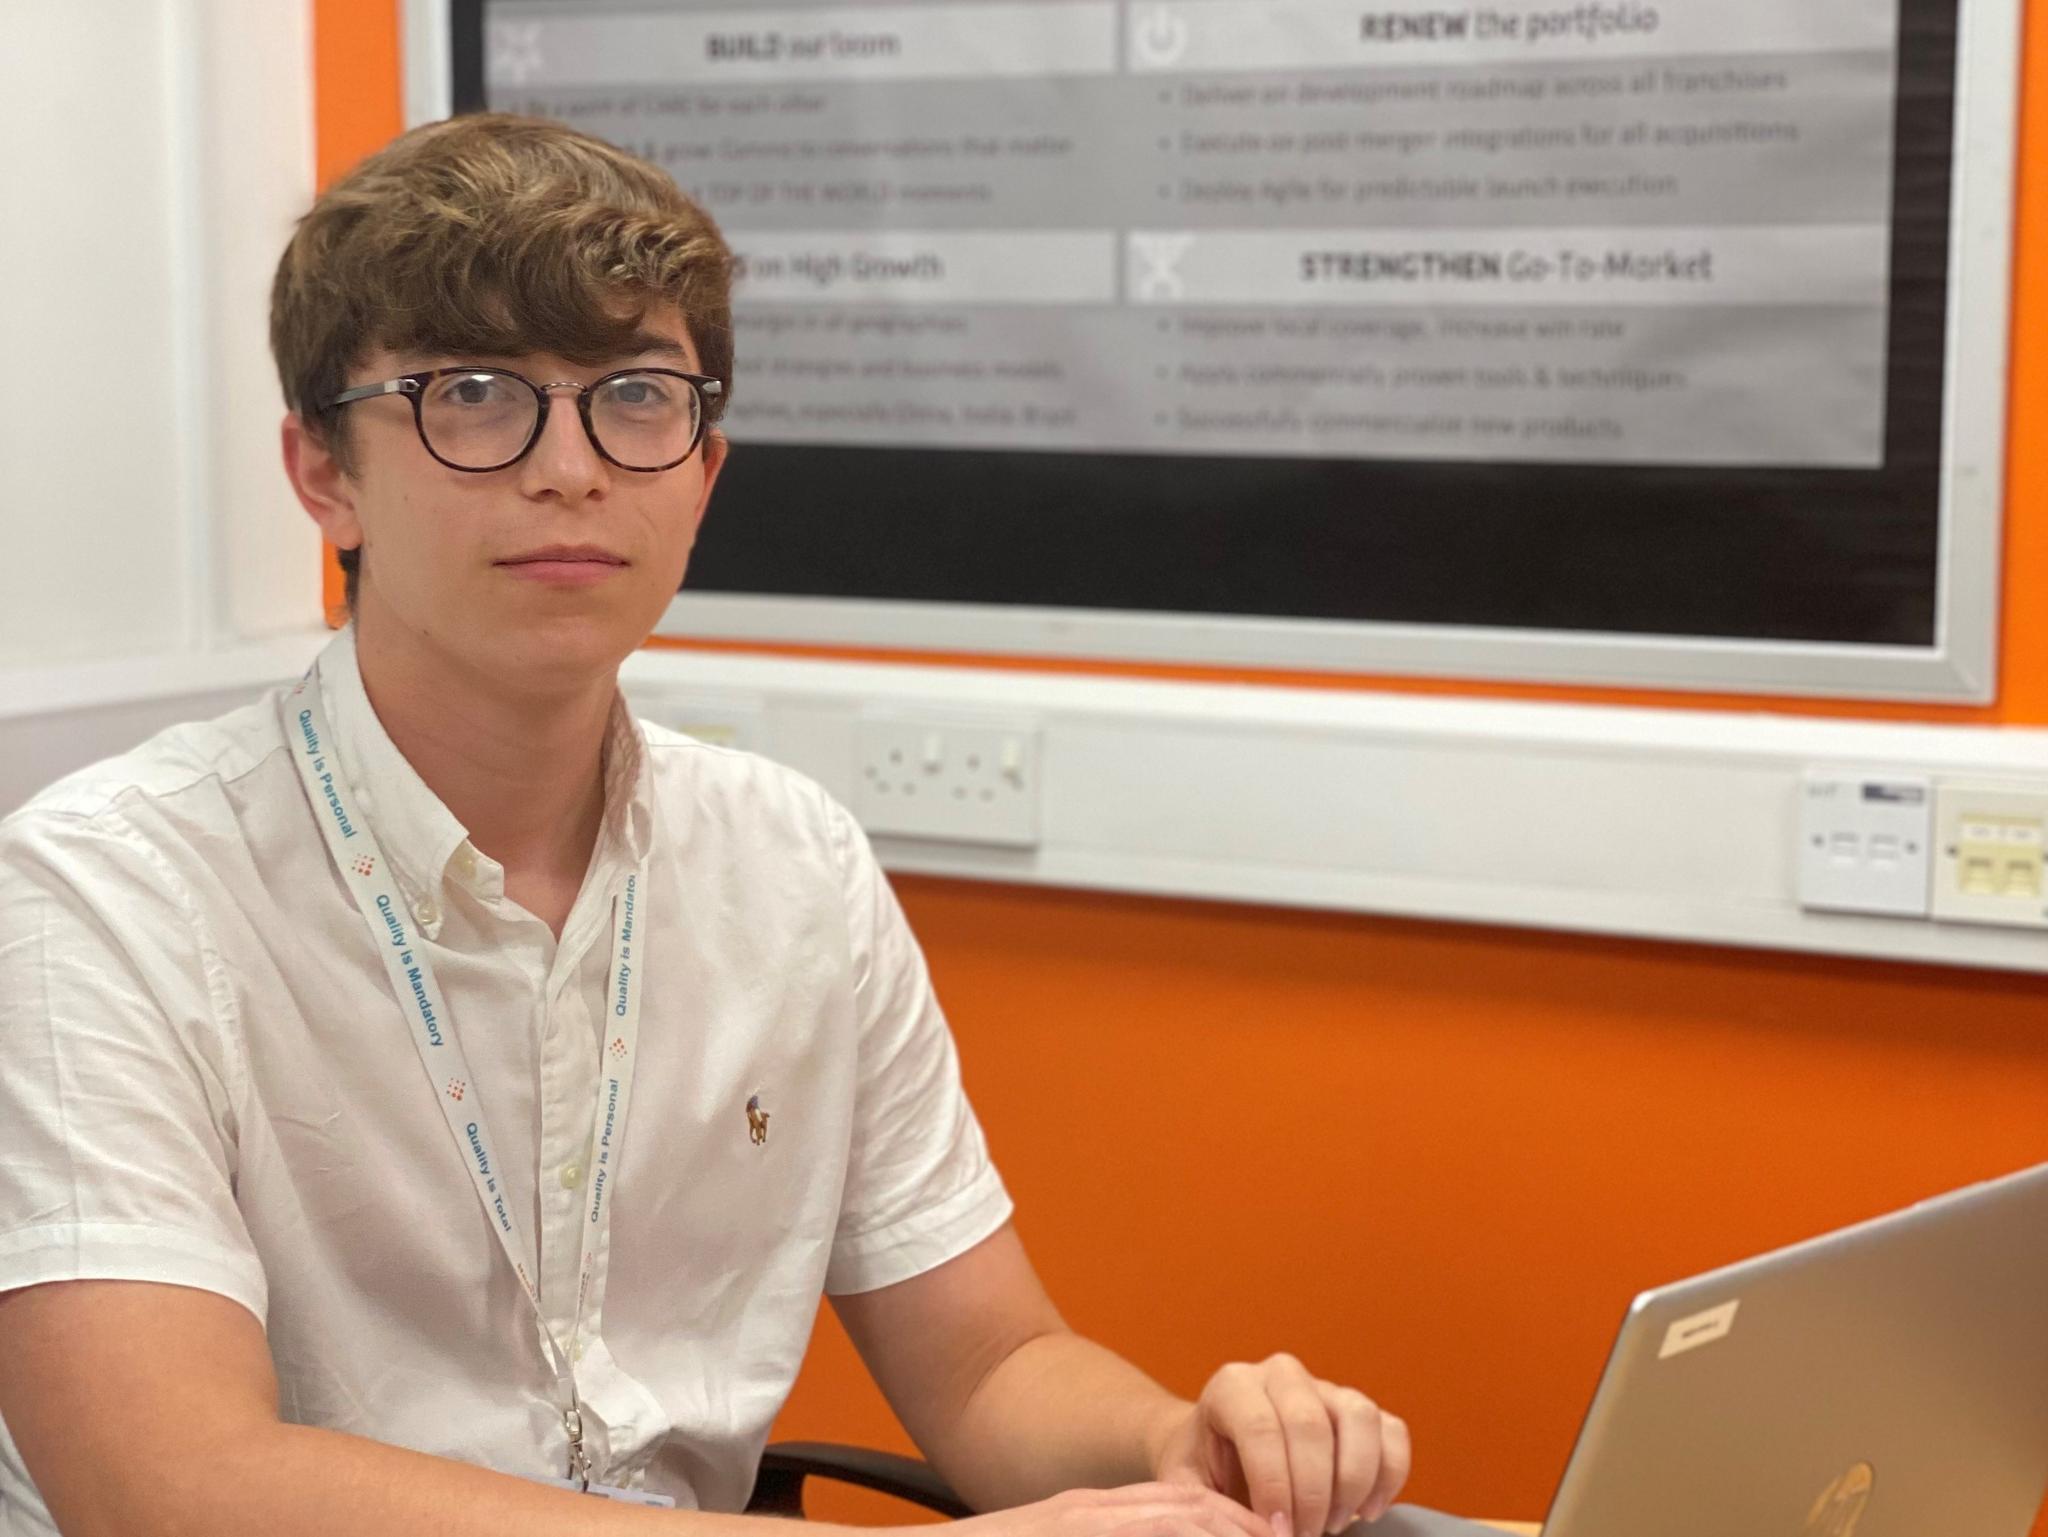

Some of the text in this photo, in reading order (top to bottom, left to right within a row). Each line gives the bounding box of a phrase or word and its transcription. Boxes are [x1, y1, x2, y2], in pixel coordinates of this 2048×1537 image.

[704, 31, 783, 61] BUILD
[1360, 2, 1660, 43] RENEW the portfolio
[789, 252, 843, 287] High
[850, 251, 946, 282] Growth
[1299, 248, 1715, 283] STRENGTHEN Go-To-Market
[299, 708, 358, 840] Quality is Personal
[375, 893, 445, 1048] Quality is Mandatory
[620, 945, 631, 962] is
[615, 963, 630, 1017] Quality
[591, 1078, 620, 1224] Quality is Personal
[466, 1121, 513, 1234] Quality is Total
